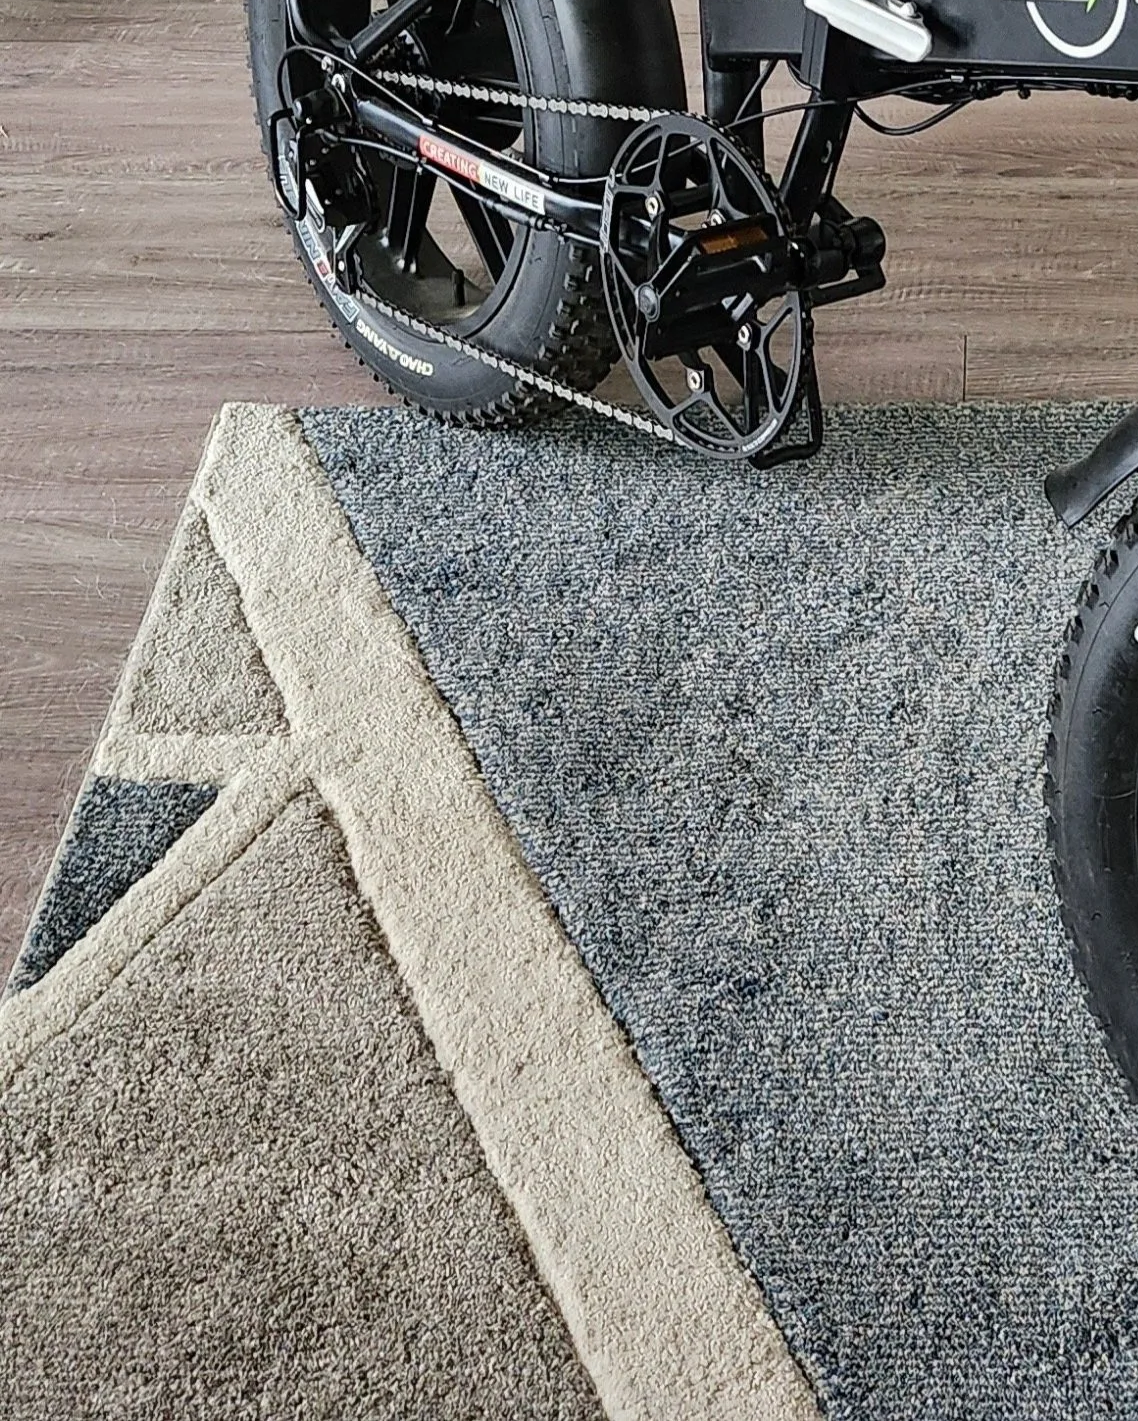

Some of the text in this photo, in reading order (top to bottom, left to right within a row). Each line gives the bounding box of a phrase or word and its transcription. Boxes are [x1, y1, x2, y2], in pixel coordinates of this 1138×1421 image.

[422, 140, 540, 209] CREATING NEW LIFE
[356, 318, 434, 377] CHAOYANG
